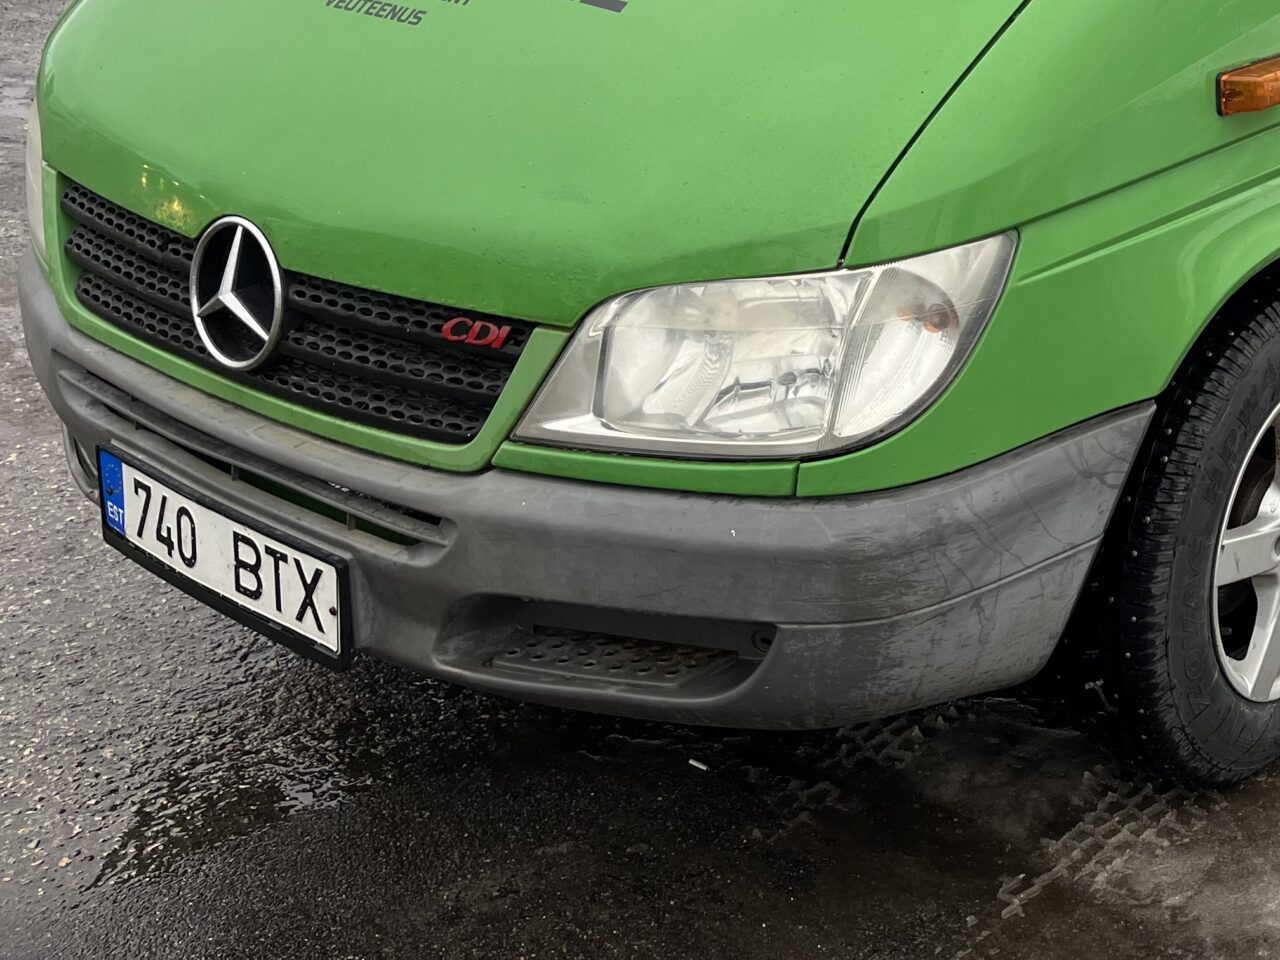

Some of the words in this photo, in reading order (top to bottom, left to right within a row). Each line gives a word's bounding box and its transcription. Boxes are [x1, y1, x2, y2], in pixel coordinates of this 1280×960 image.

[441, 317, 513, 350] CDI
[107, 501, 125, 526] EST
[133, 477, 198, 569] 740
[232, 529, 326, 634] BTX
